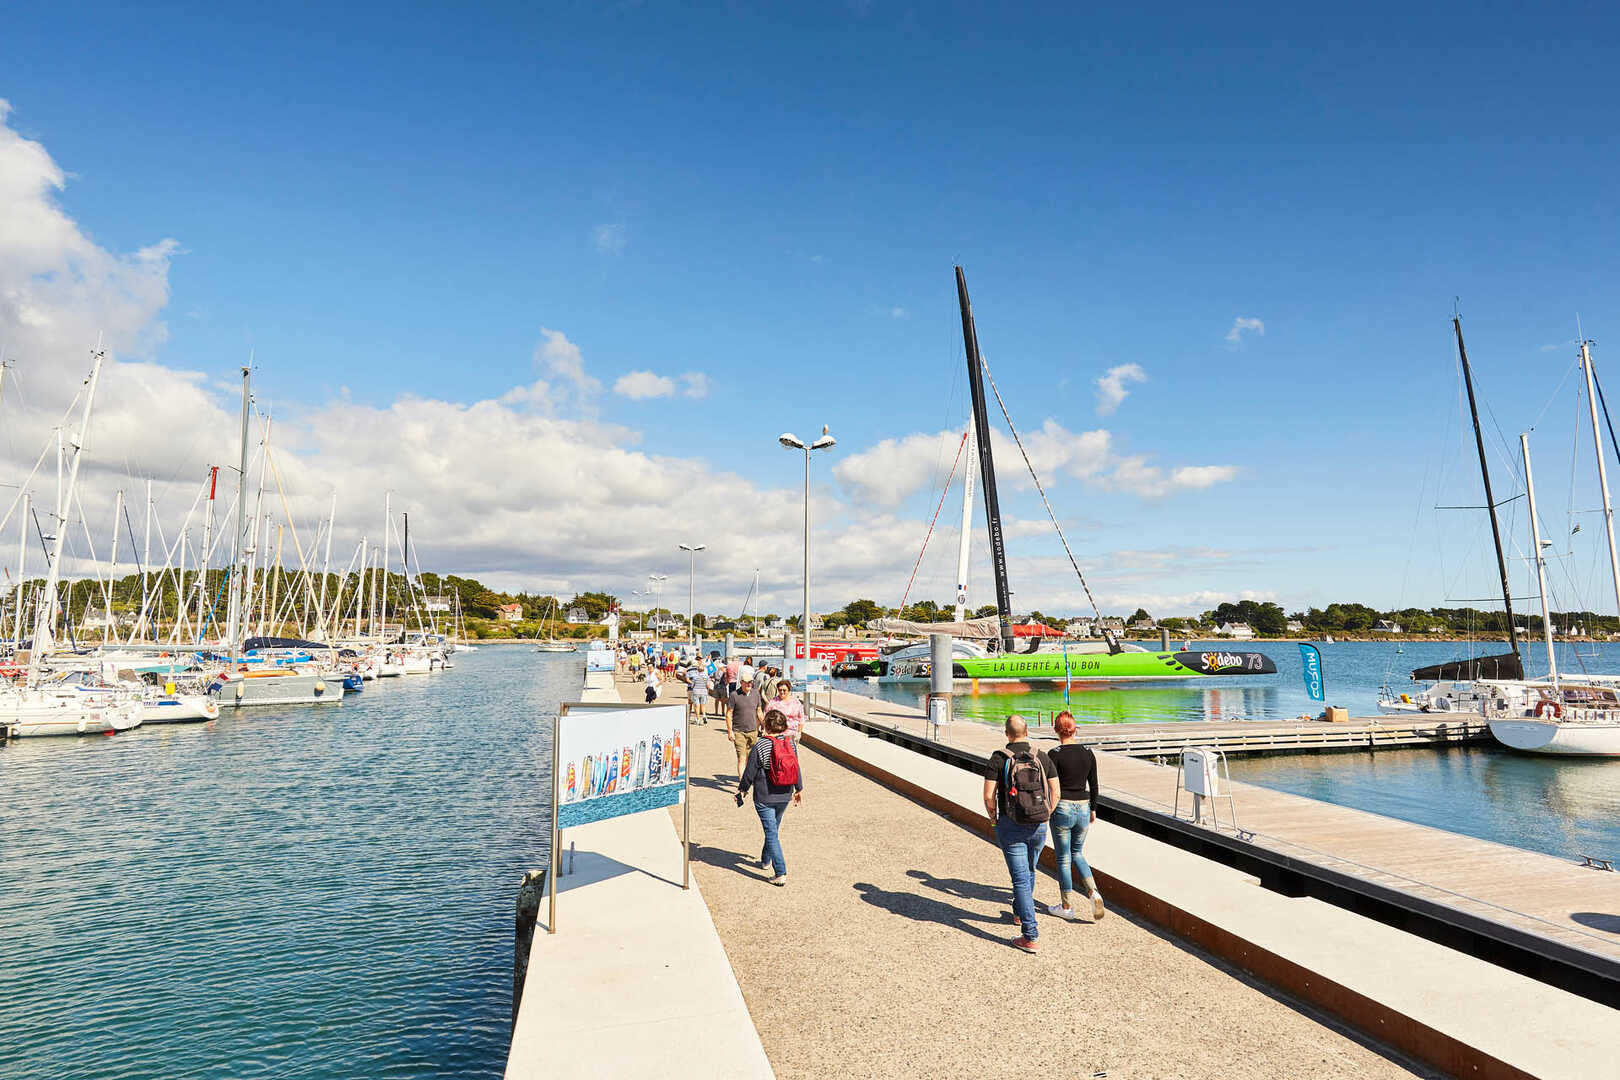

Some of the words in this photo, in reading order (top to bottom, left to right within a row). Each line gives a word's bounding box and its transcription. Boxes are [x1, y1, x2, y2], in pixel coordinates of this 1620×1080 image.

[994, 663, 1005, 672] LA
[1054, 662, 1060, 670] A
[1081, 661, 1101, 670] BON
[1201, 652, 1242, 670] Sodebo
[1247, 653, 1263, 670] 73
